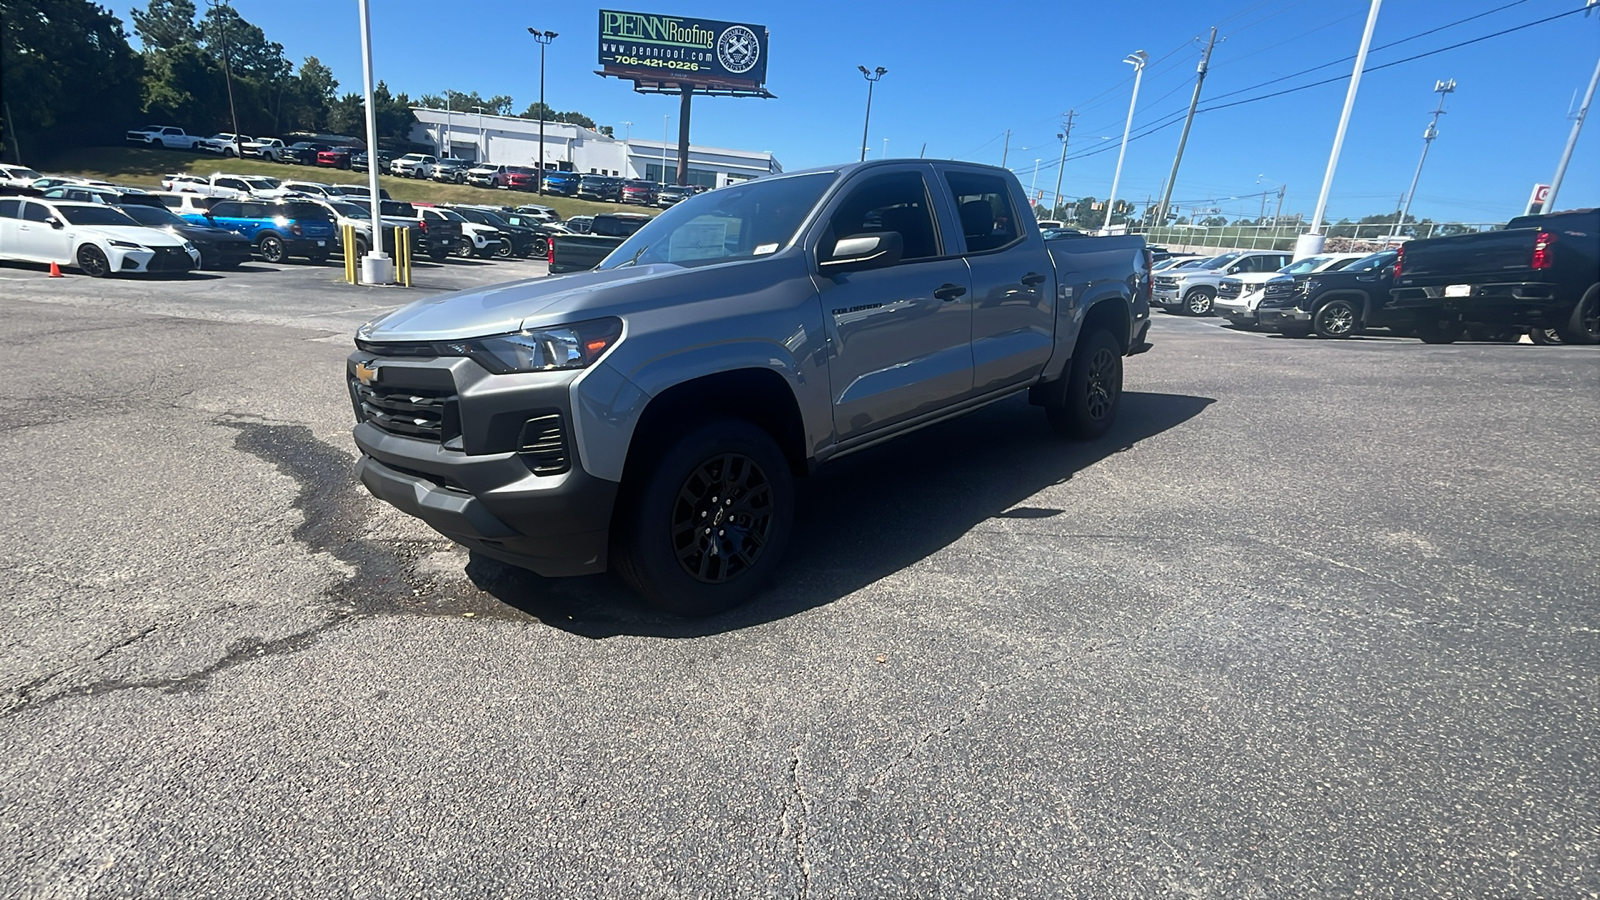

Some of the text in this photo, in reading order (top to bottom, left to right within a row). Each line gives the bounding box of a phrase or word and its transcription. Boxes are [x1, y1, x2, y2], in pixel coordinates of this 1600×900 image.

[602, 11, 714, 49] PENN Roofing
[602, 43, 712, 62] www.pennroof.com
[615, 55, 699, 71] 706-421-0226
[832, 303, 882, 315] COLORADO
